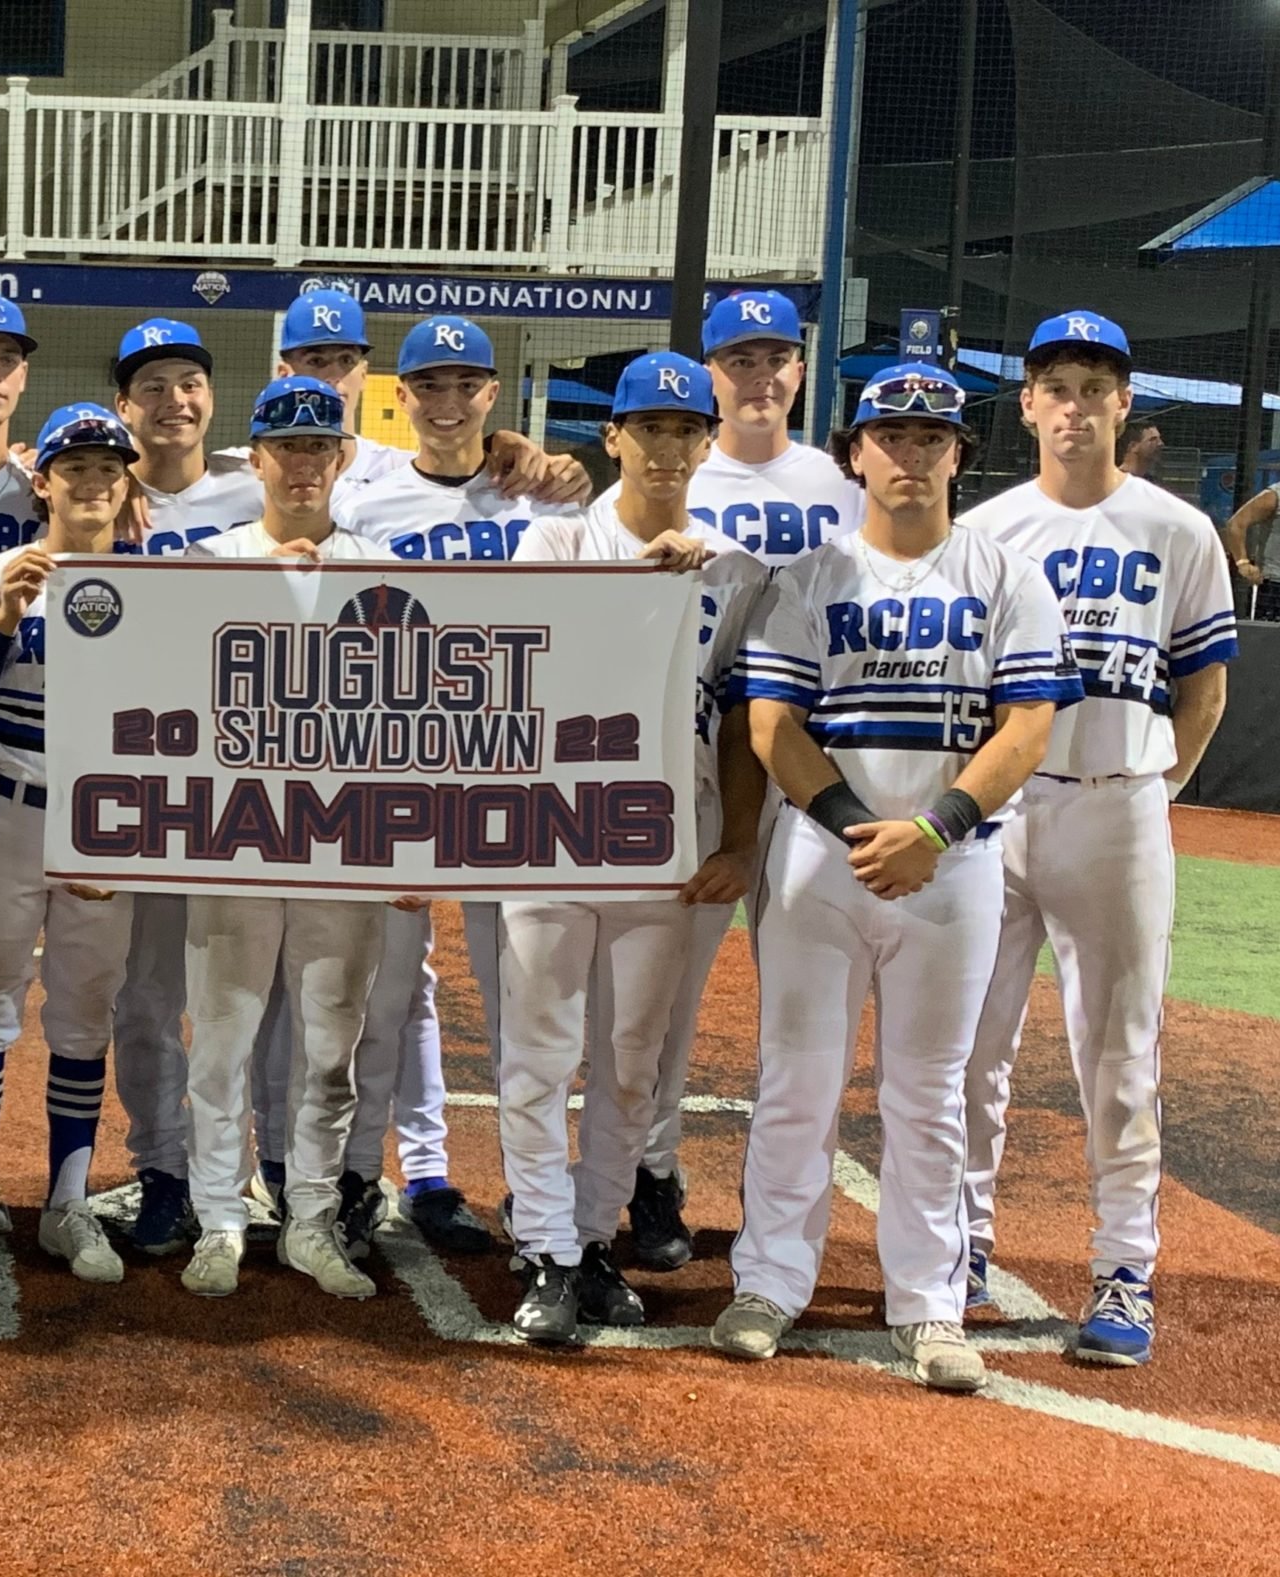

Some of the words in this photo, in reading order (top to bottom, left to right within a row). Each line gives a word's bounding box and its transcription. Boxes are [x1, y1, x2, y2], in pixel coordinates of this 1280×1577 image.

[312, 305, 342, 333] RC
[740, 299, 772, 325] RC
[1065, 316, 1100, 342] RC
[143, 326, 173, 347] RC
[433, 324, 465, 352] RC
[906, 344, 932, 355] FIELD
[658, 367, 690, 399] RC
[687, 501, 839, 555] CBC
[1043, 546, 1161, 606] CBC
[67, 602, 120, 616] NATION
[826, 596, 987, 657] RCBC
[1064, 606, 1120, 627] rucci
[212, 622, 551, 714] AUGUST
[861, 655, 949, 679] marucci
[1099, 639, 1160, 700] 44
[113, 708, 199, 757] 20
[554, 712, 640, 763] 22
[942, 690, 987, 749] 15
[215, 707, 545, 775] SHOWDOWN
[71, 773, 675, 868] CHAMPIONS
